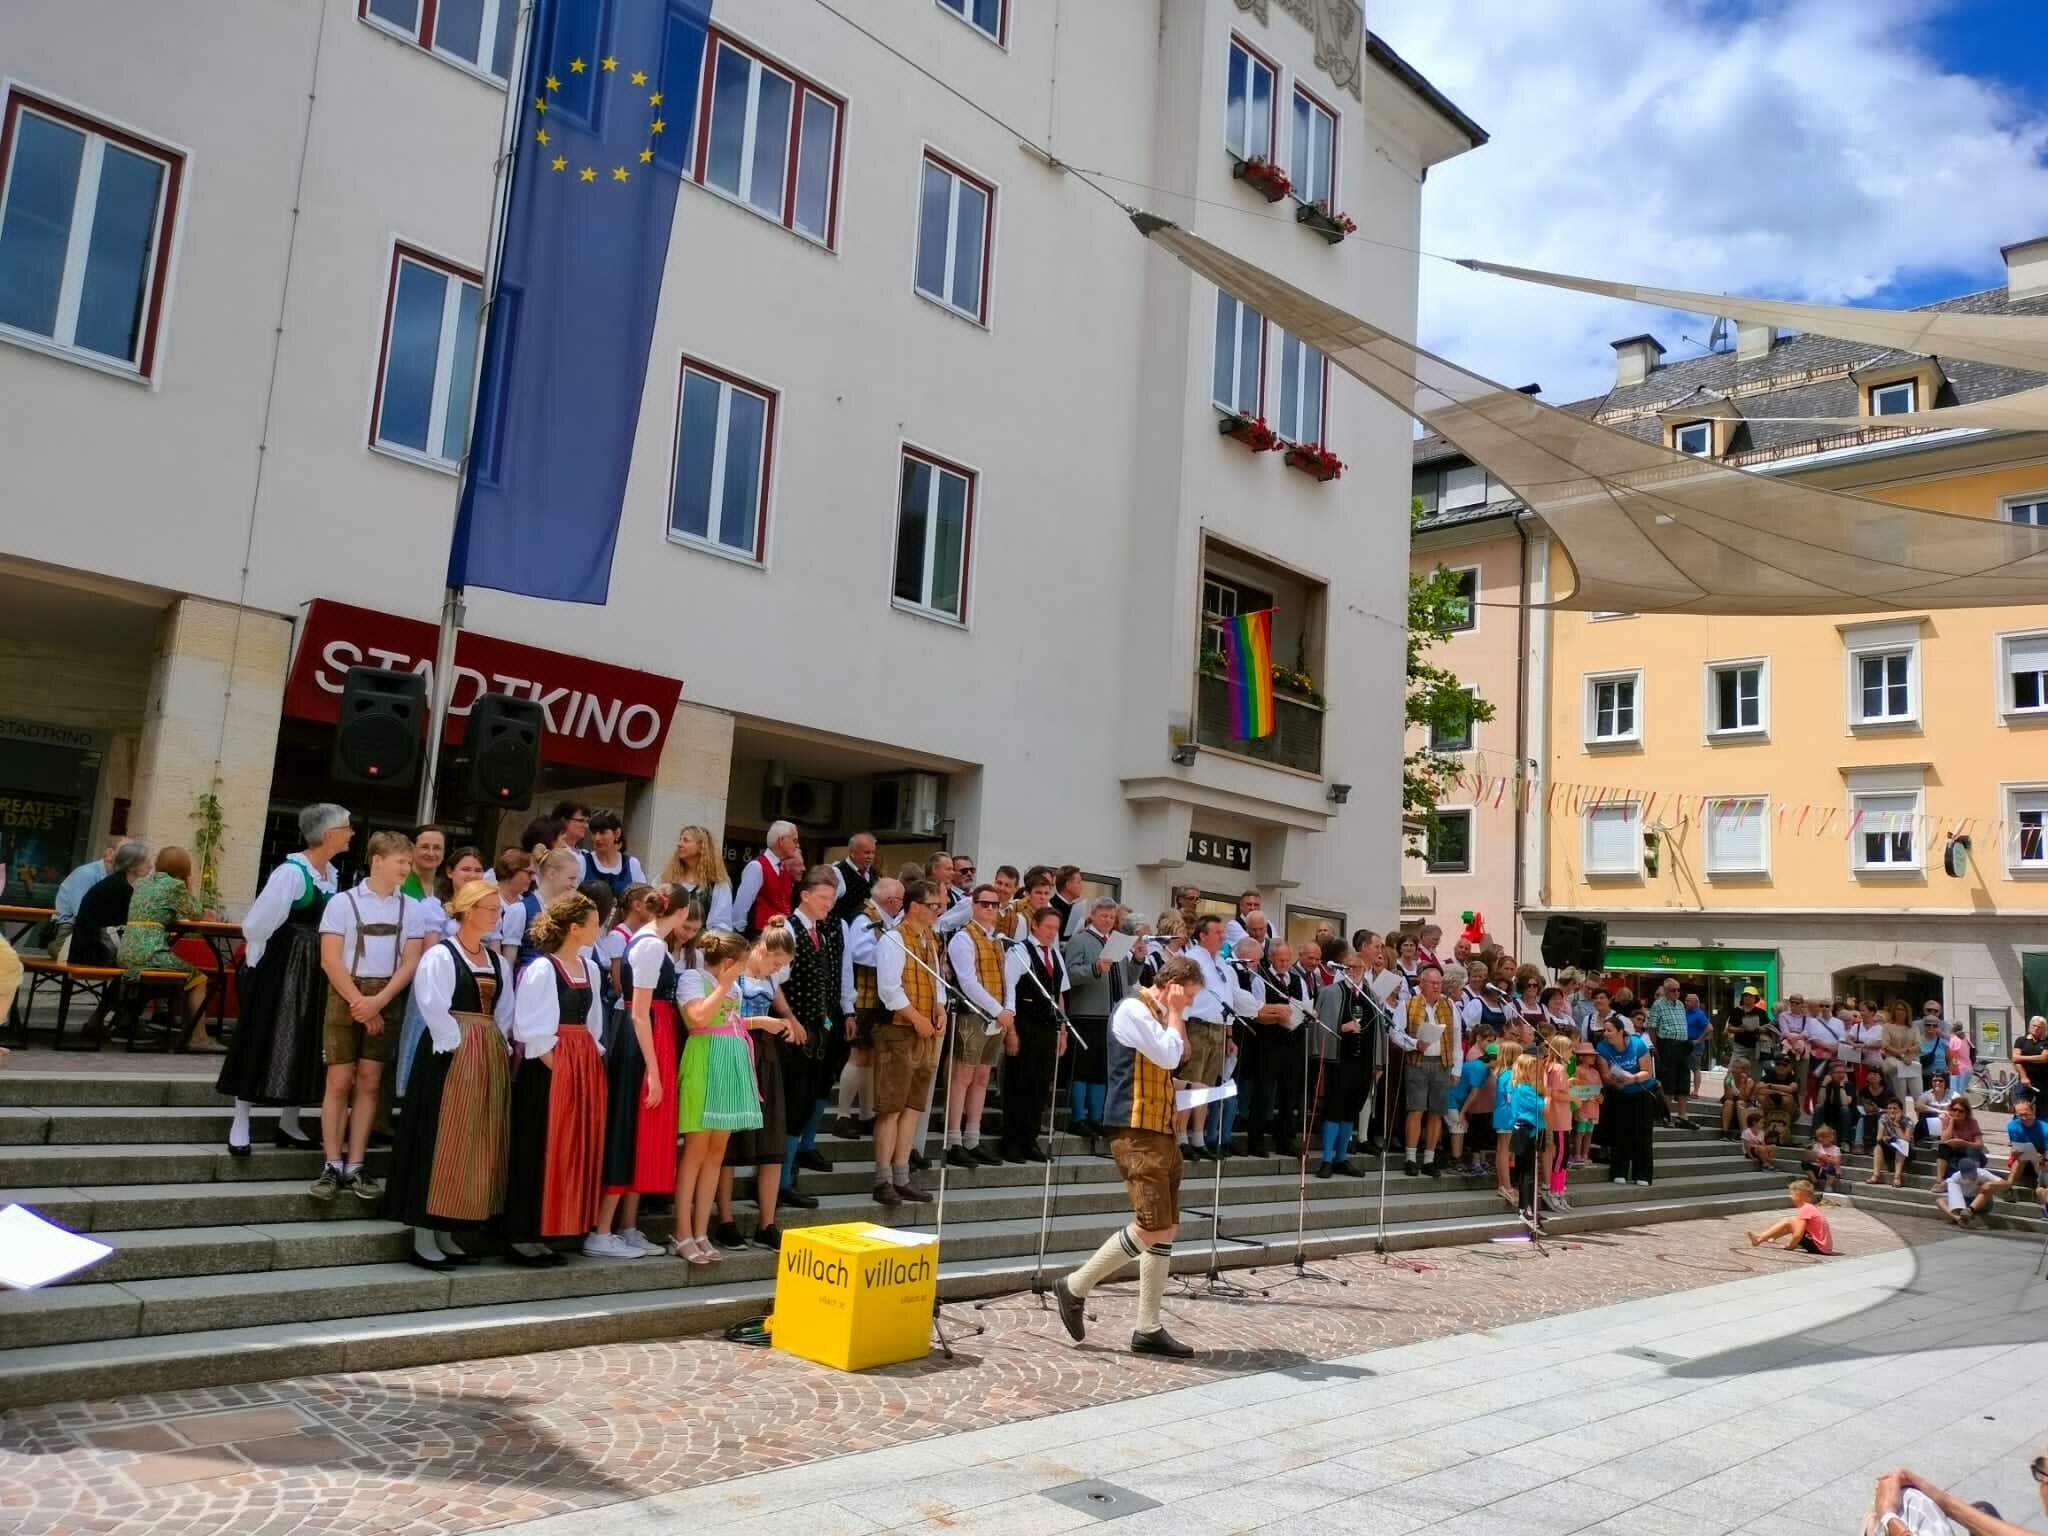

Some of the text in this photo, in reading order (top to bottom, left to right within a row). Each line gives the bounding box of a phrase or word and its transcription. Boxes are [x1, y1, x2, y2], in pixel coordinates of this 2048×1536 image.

[314, 640, 661, 750] STADTKINO
[1188, 838, 1249, 864] ISLEY
[787, 1248, 849, 1288] villach
[864, 1254, 930, 1289] villach
